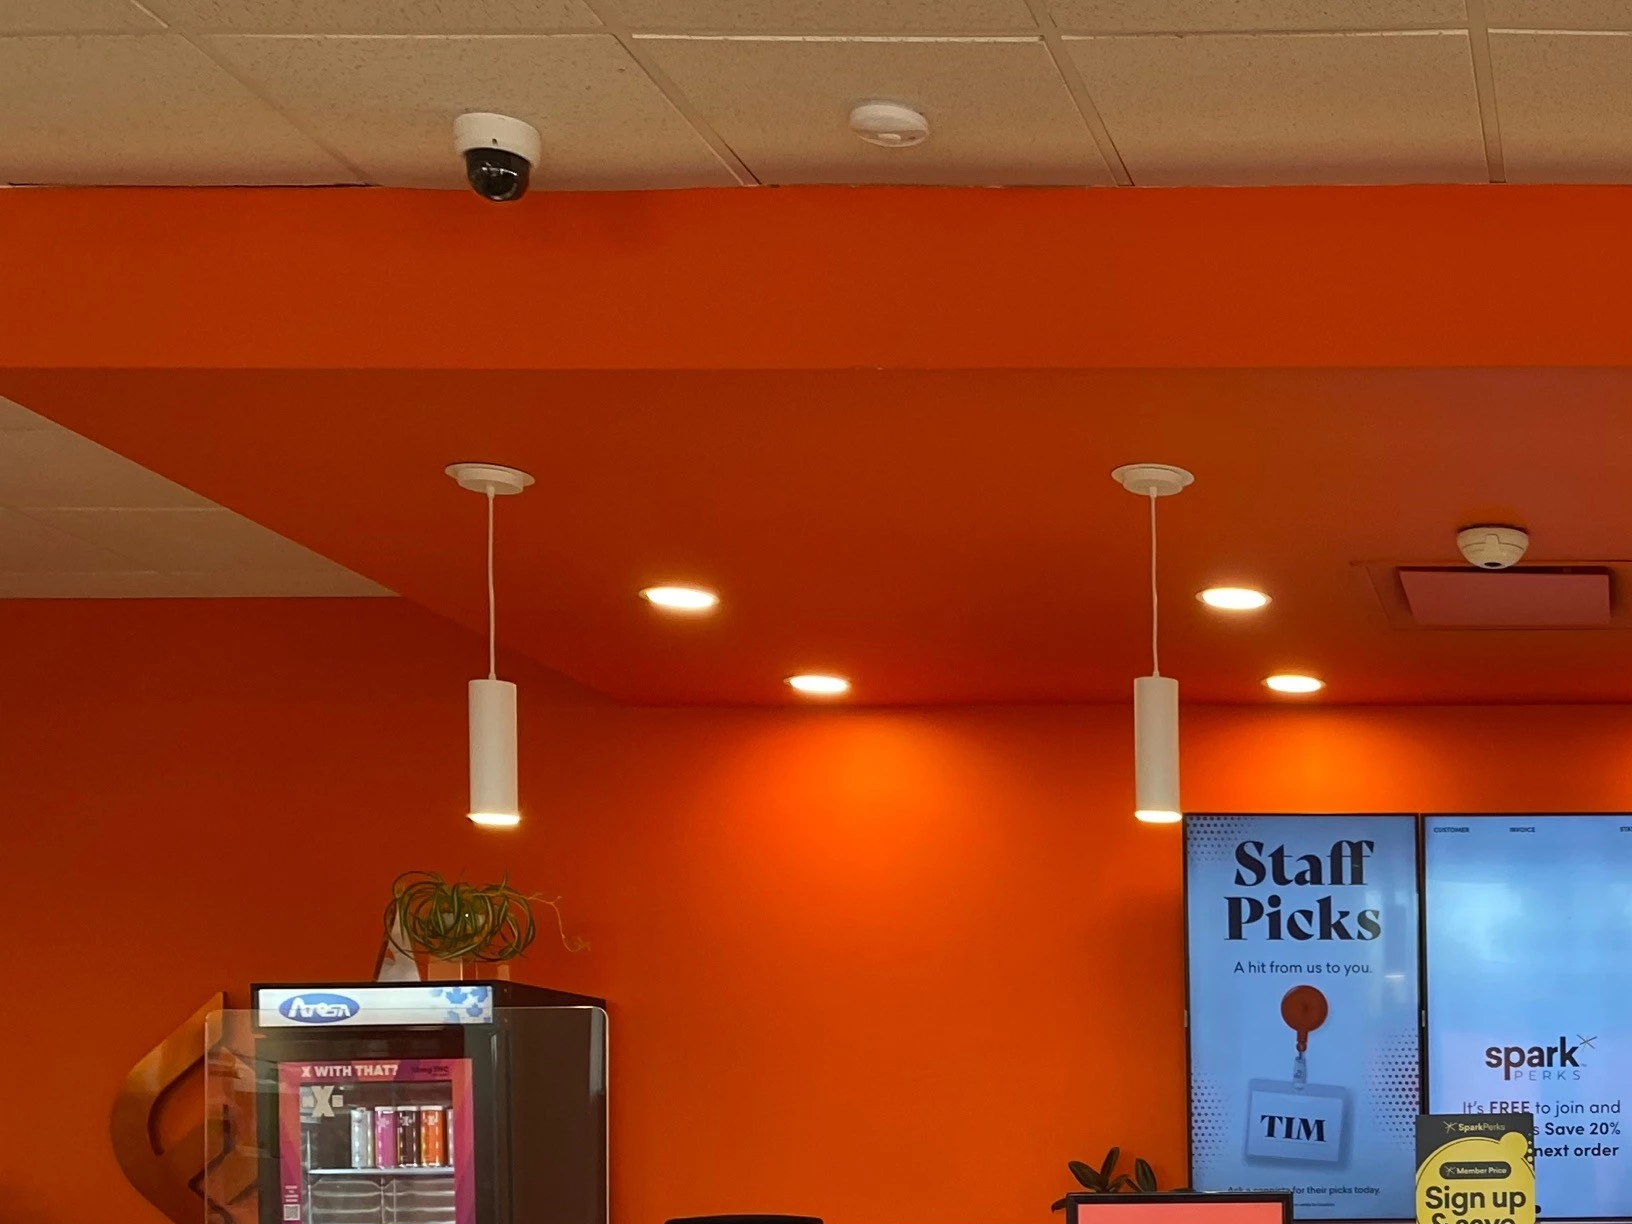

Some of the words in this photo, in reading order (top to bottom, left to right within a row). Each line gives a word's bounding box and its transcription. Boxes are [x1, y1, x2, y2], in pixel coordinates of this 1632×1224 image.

[1234, 840, 1375, 886] Staff
[1223, 894, 1382, 941] Picks
[1233, 962, 1245, 974] A
[1249, 961, 1266, 974] hit
[1270, 961, 1302, 974] from
[1307, 963, 1322, 974] us
[1327, 962, 1340, 974] to
[1344, 963, 1373, 977] you.
[1485, 1036, 1580, 1081] spark
[314, 1065, 352, 1077] WITH
[355, 1064, 398, 1077] THAT?
[1514, 1070, 1581, 1081] PERKS
[1489, 1101, 1530, 1115] FREE
[1536, 1102, 1551, 1114] to
[1555, 1100, 1584, 1118] join
[1589, 1100, 1621, 1114] and
[1260, 1114, 1327, 1143] TIM
[1458, 1122, 1506, 1133] SparkPerks
[1544, 1121, 1585, 1135] Save
[1589, 1122, 1621, 1135] 20%
[1534, 1144, 1569, 1157] next
[1573, 1143, 1619, 1157] order
[1456, 1166, 1487, 1175] Member
[1488, 1166, 1507, 1174] Price
[1293, 1186, 1305, 1194] for
[1306, 1185, 1327, 1194] their
[1329, 1185, 1352, 1196] picks
[1354, 1185, 1380, 1196] today.
[1425, 1185, 1486, 1215] Sign
[1492, 1190, 1527, 1215] up
